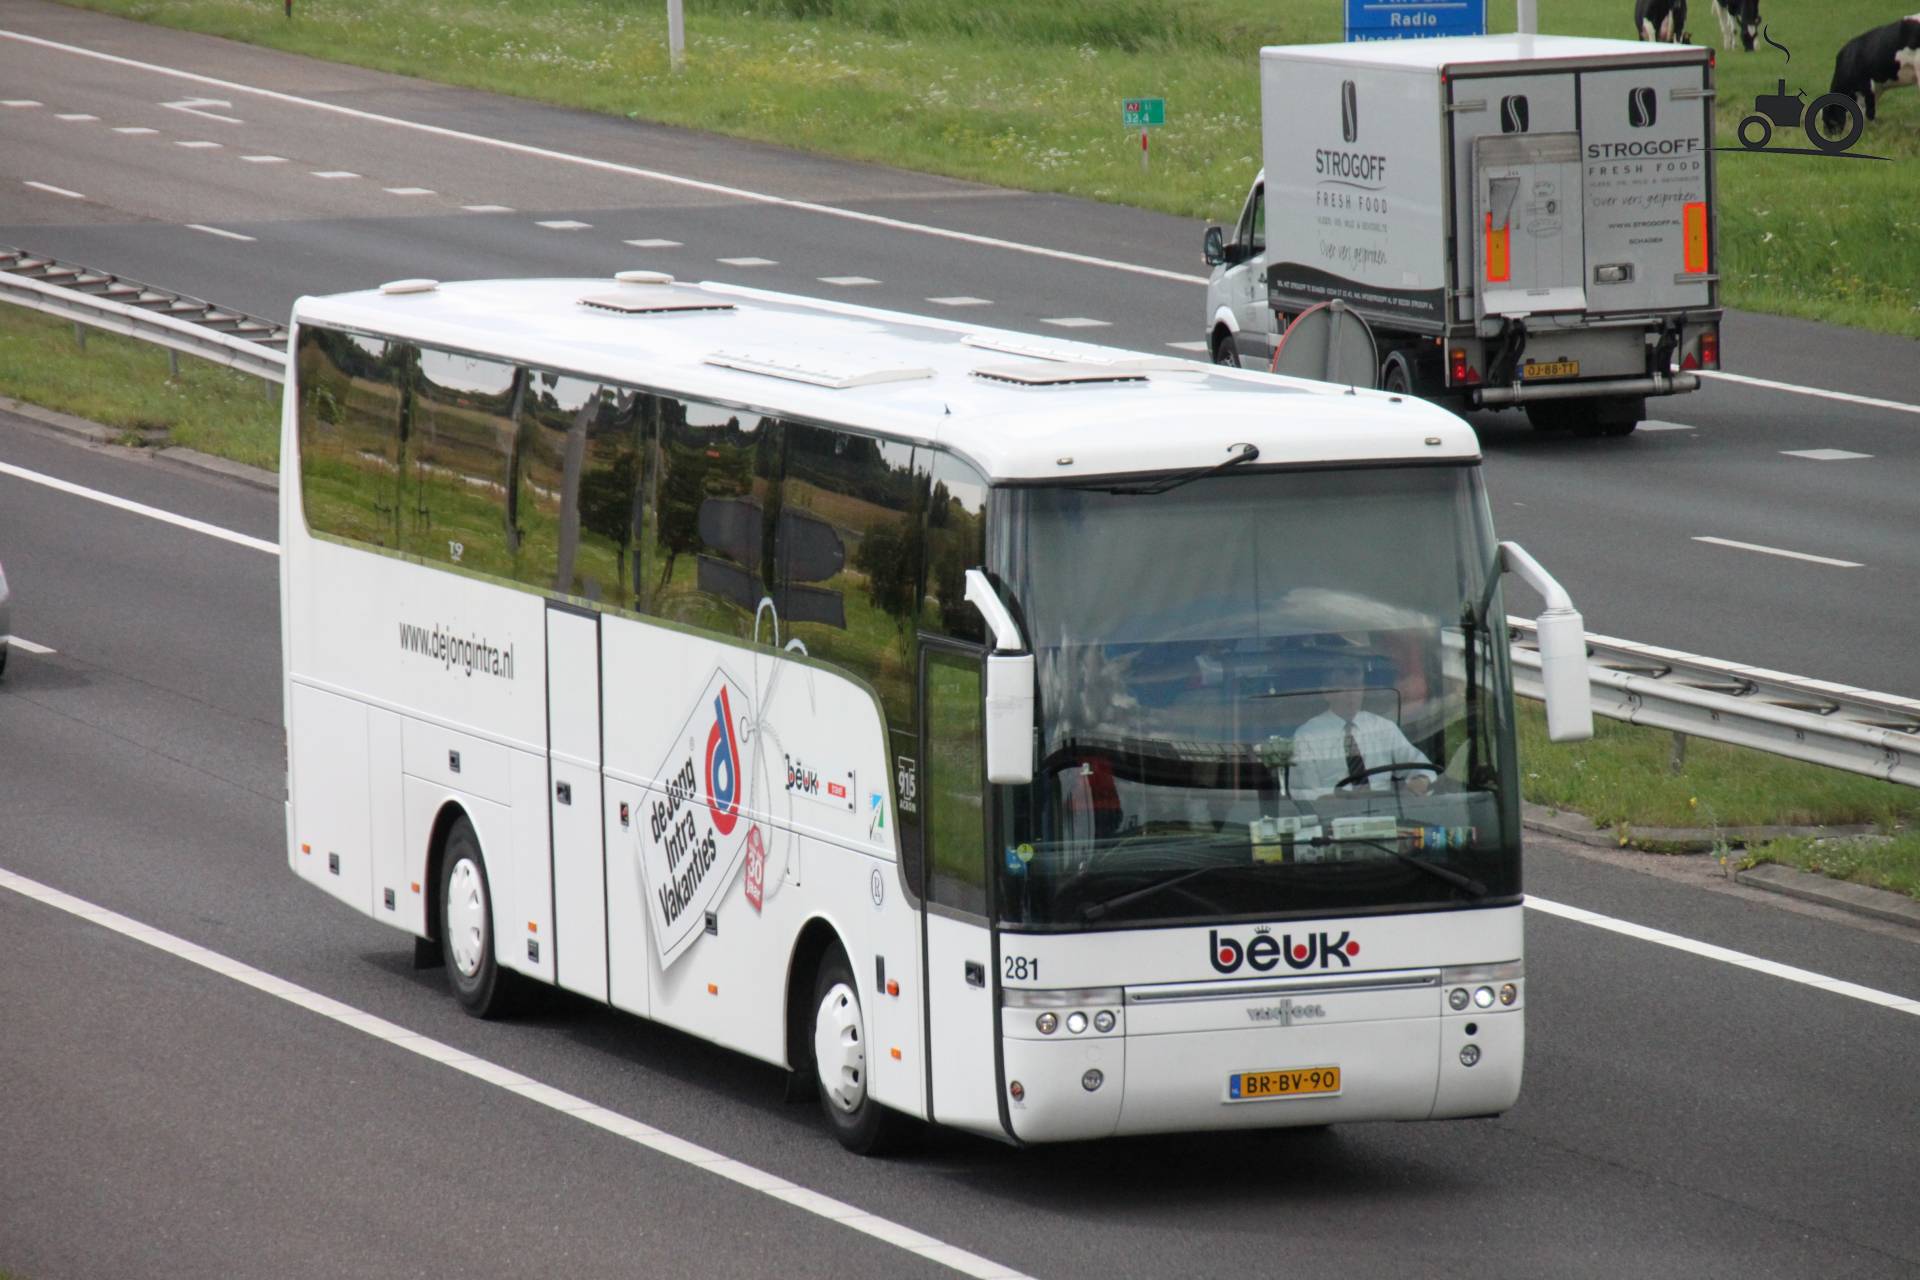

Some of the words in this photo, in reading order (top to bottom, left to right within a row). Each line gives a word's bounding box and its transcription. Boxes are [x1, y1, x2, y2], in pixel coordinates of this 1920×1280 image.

[1391, 12, 1437, 27] Radio
[1588, 138, 1699, 158] STROGOFF
[1316, 148, 1386, 181] STROGOFF
[1589, 165, 1642, 176] FRESH
[1656, 161, 1700, 172] FOOD
[1316, 191, 1351, 209] FRESH
[1359, 196, 1388, 214] FOOD
[399, 622, 514, 680] www.dejongintra.nl
[664, 809, 696, 874] Intra
[658, 827, 717, 927] Vakanties
[1005, 955, 1038, 981] 281
[1247, 1071, 1335, 1094] BR-BV-90
